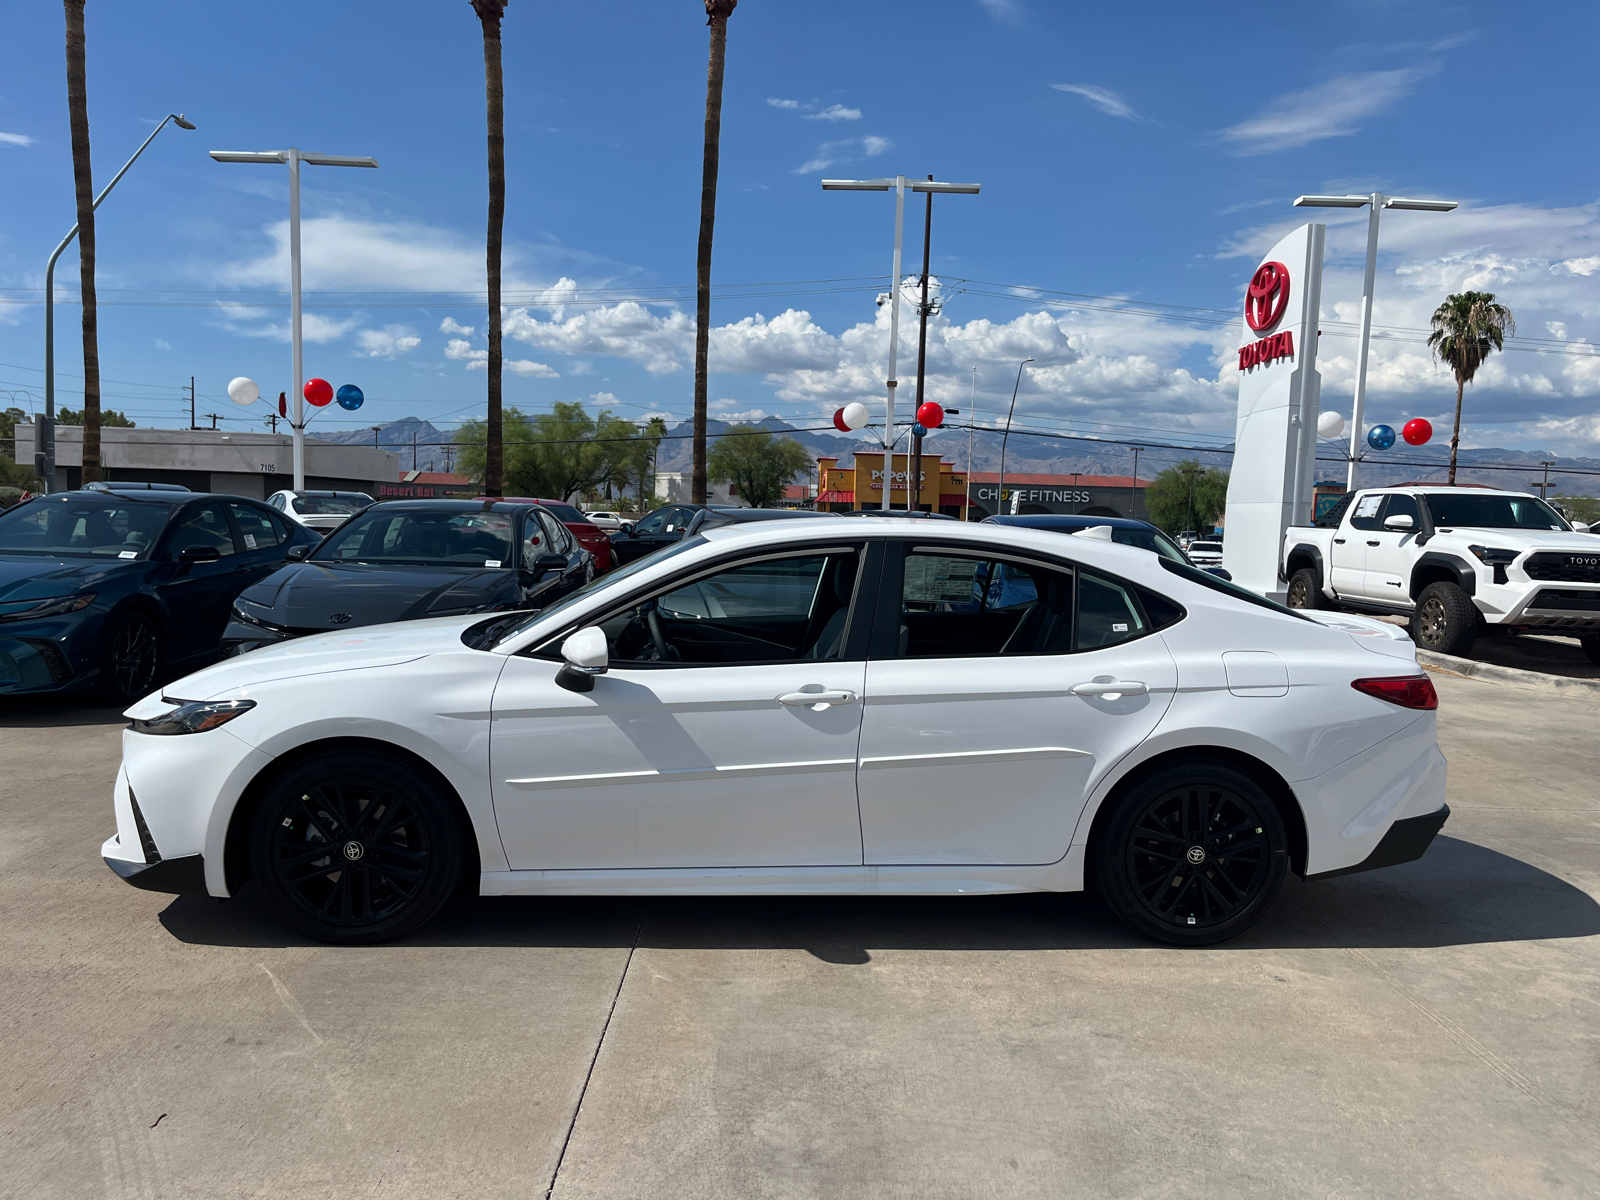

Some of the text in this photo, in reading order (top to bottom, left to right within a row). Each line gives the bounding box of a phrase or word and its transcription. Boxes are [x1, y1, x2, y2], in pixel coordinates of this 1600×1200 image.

[1239, 331, 1294, 371] TOYOTA
[260, 463, 275, 472] 7105
[380, 485, 414, 497] Desert
[416, 486, 435, 498] Rat
[1029, 490, 1090, 503] FITNESS
[1570, 557, 1600, 565] TOYO
